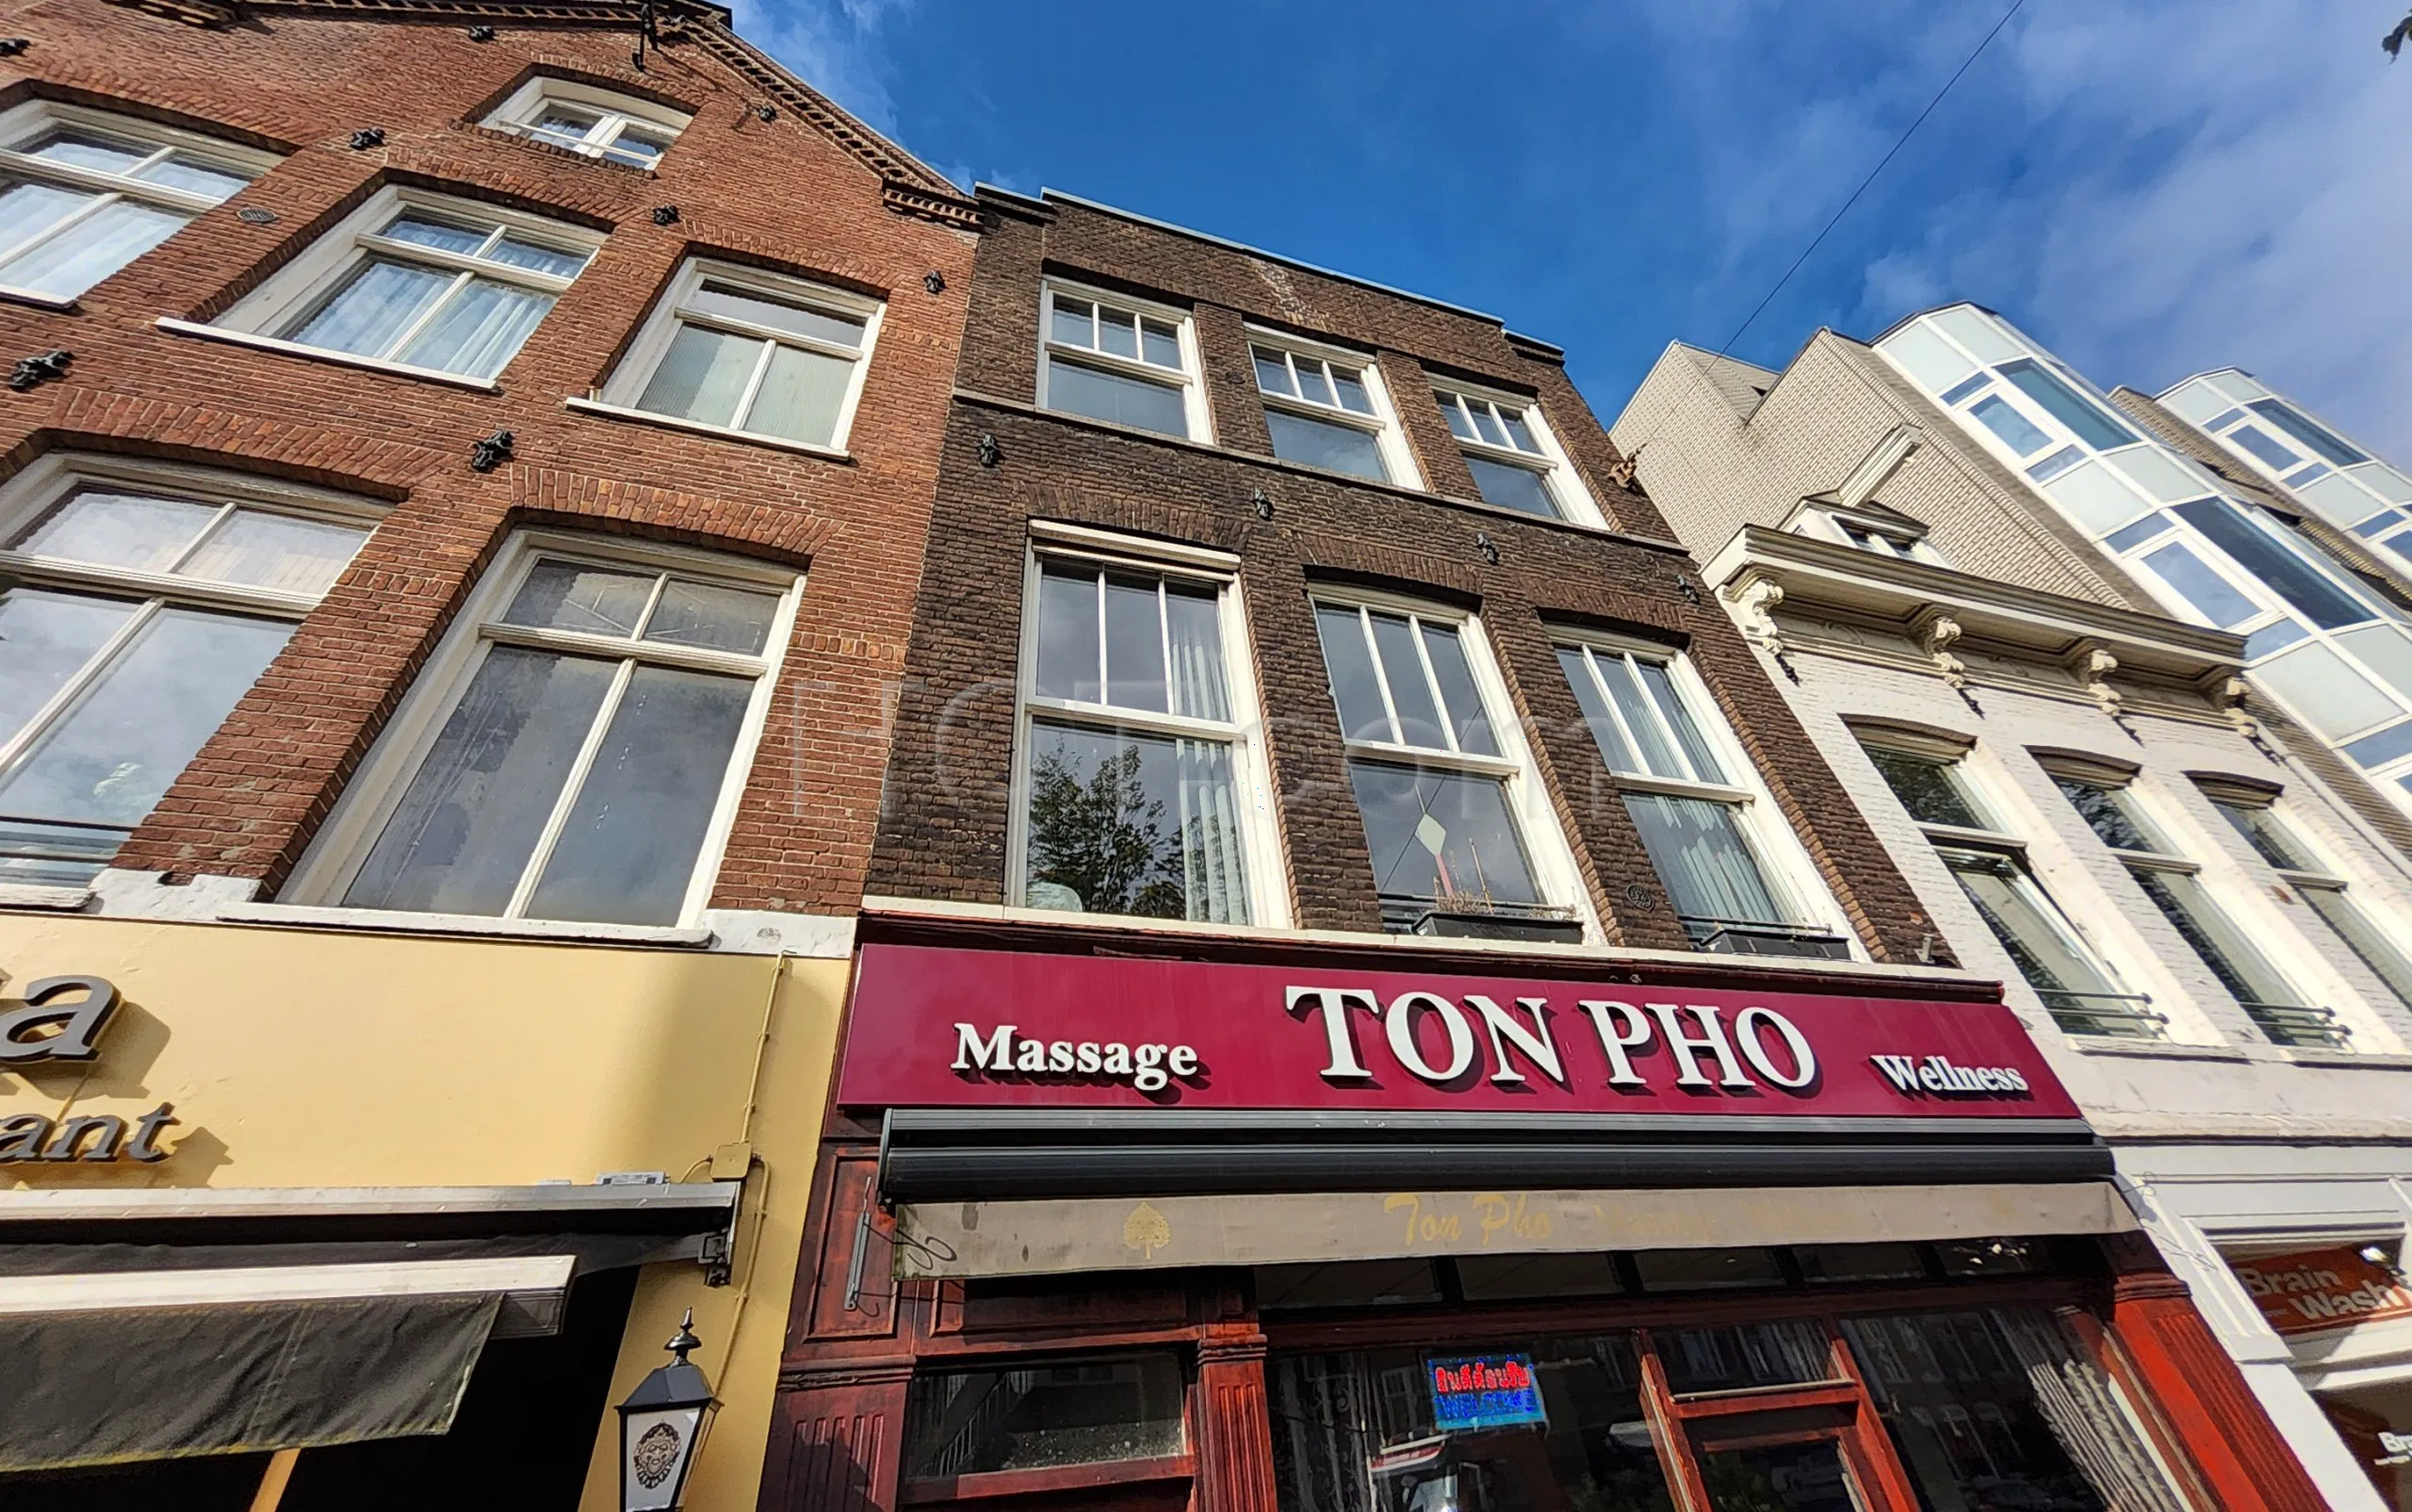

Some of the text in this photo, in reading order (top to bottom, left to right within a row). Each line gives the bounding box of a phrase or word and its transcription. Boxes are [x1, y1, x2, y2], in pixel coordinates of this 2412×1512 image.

[0, 967, 122, 1063] a
[1285, 985, 1817, 1088] TON PHO
[950, 1022, 1198, 1092] Massage
[1870, 1054, 2029, 1094] Wellness
[1384, 1194, 1460, 1245] Ton
[1472, 1193, 1551, 1245] Pho
[2239, 1265, 2341, 1296] Brain
[2288, 1279, 2404, 1320] Wash
